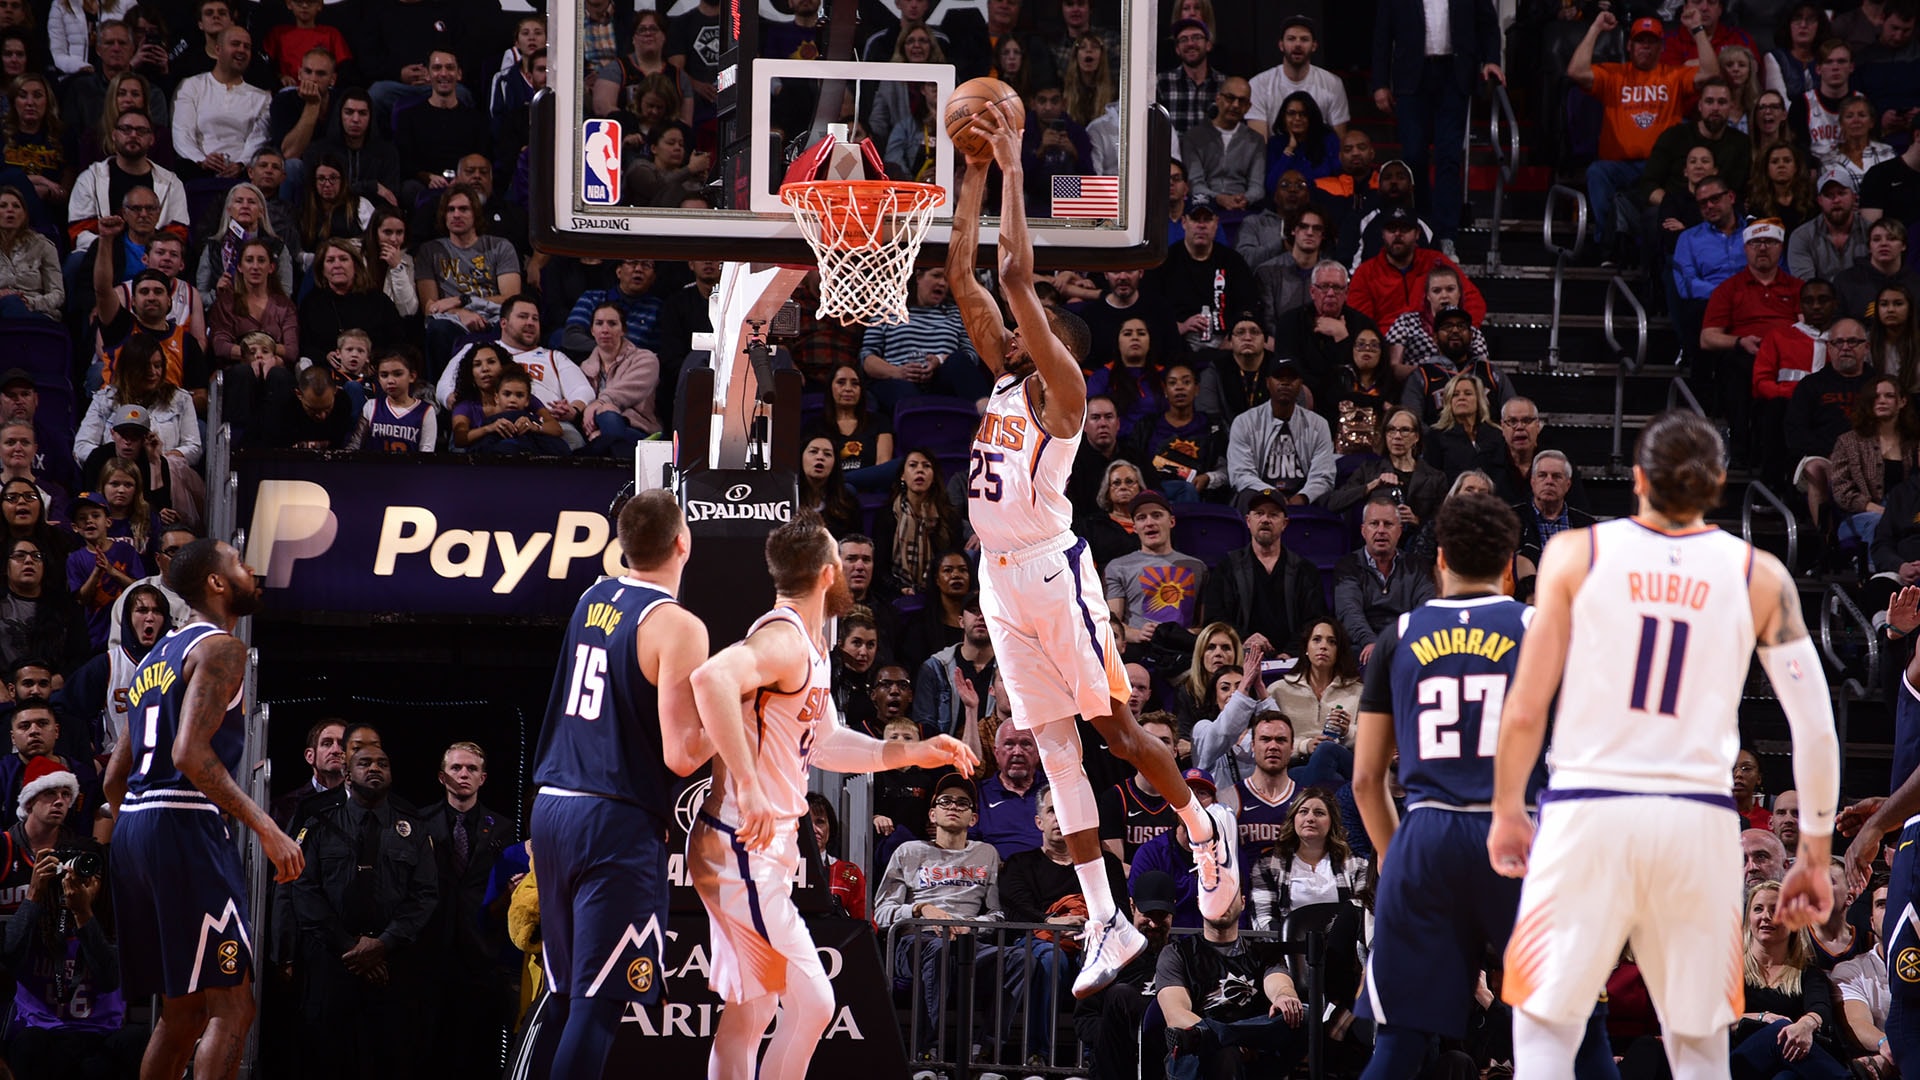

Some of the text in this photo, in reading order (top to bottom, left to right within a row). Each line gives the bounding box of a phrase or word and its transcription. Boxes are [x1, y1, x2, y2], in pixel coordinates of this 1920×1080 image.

[1621, 84, 1669, 103] SUNS
[1811, 124, 1846, 143] PHOE
[587, 184, 607, 200] NBA
[571, 217, 631, 231] SPALDING
[371, 422, 420, 443] PHOENIX
[968, 448, 1004, 503] 25
[687, 500, 791, 522] SPALDING
[373, 505, 630, 594] PayP
[1628, 571, 1710, 611] RUBIO
[1410, 627, 1516, 666] MURRAY
[1629, 613, 1691, 719] 11
[565, 643, 608, 720] 15
[1418, 674, 1508, 760] 27
[1239, 824, 1281, 843] PHOE
[932, 866, 988, 880] SUNS
[620, 1001, 865, 1041] ARIA
